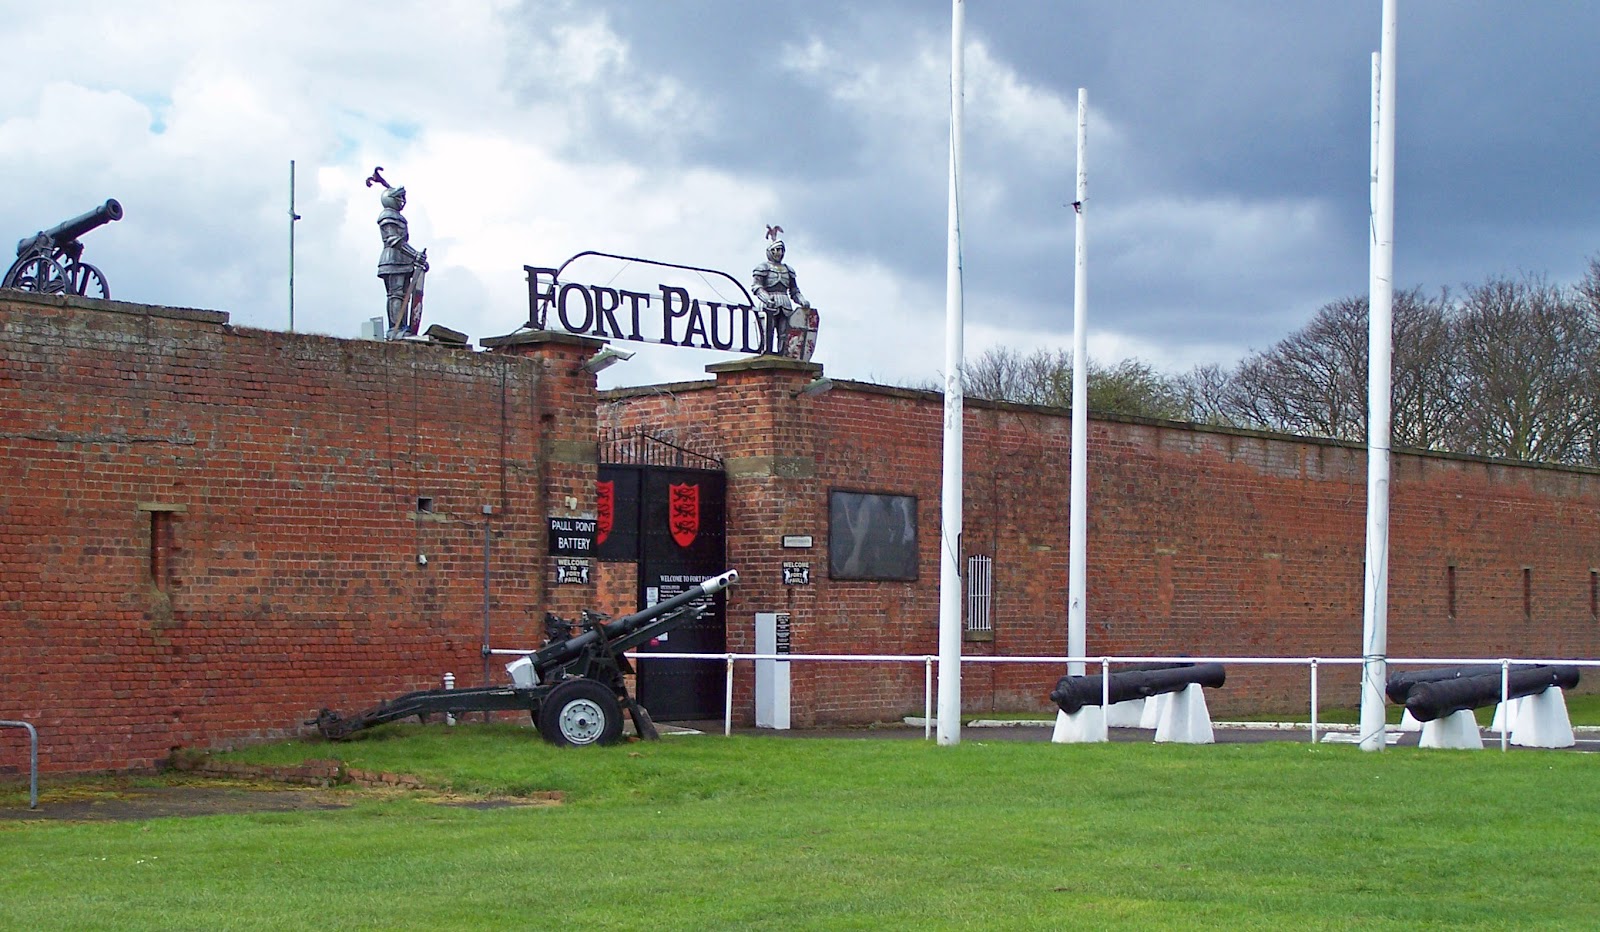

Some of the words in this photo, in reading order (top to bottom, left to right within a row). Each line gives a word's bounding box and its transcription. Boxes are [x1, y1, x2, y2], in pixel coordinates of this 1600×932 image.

[524, 264, 650, 341] FORT
[551, 520, 573, 531] PAULL
[575, 522, 596, 532] POINT
[558, 537, 591, 550] BATTERY
[660, 575, 683, 583] WELCOME
[683, 575, 690, 583] TO
[690, 575, 701, 583] FORT
